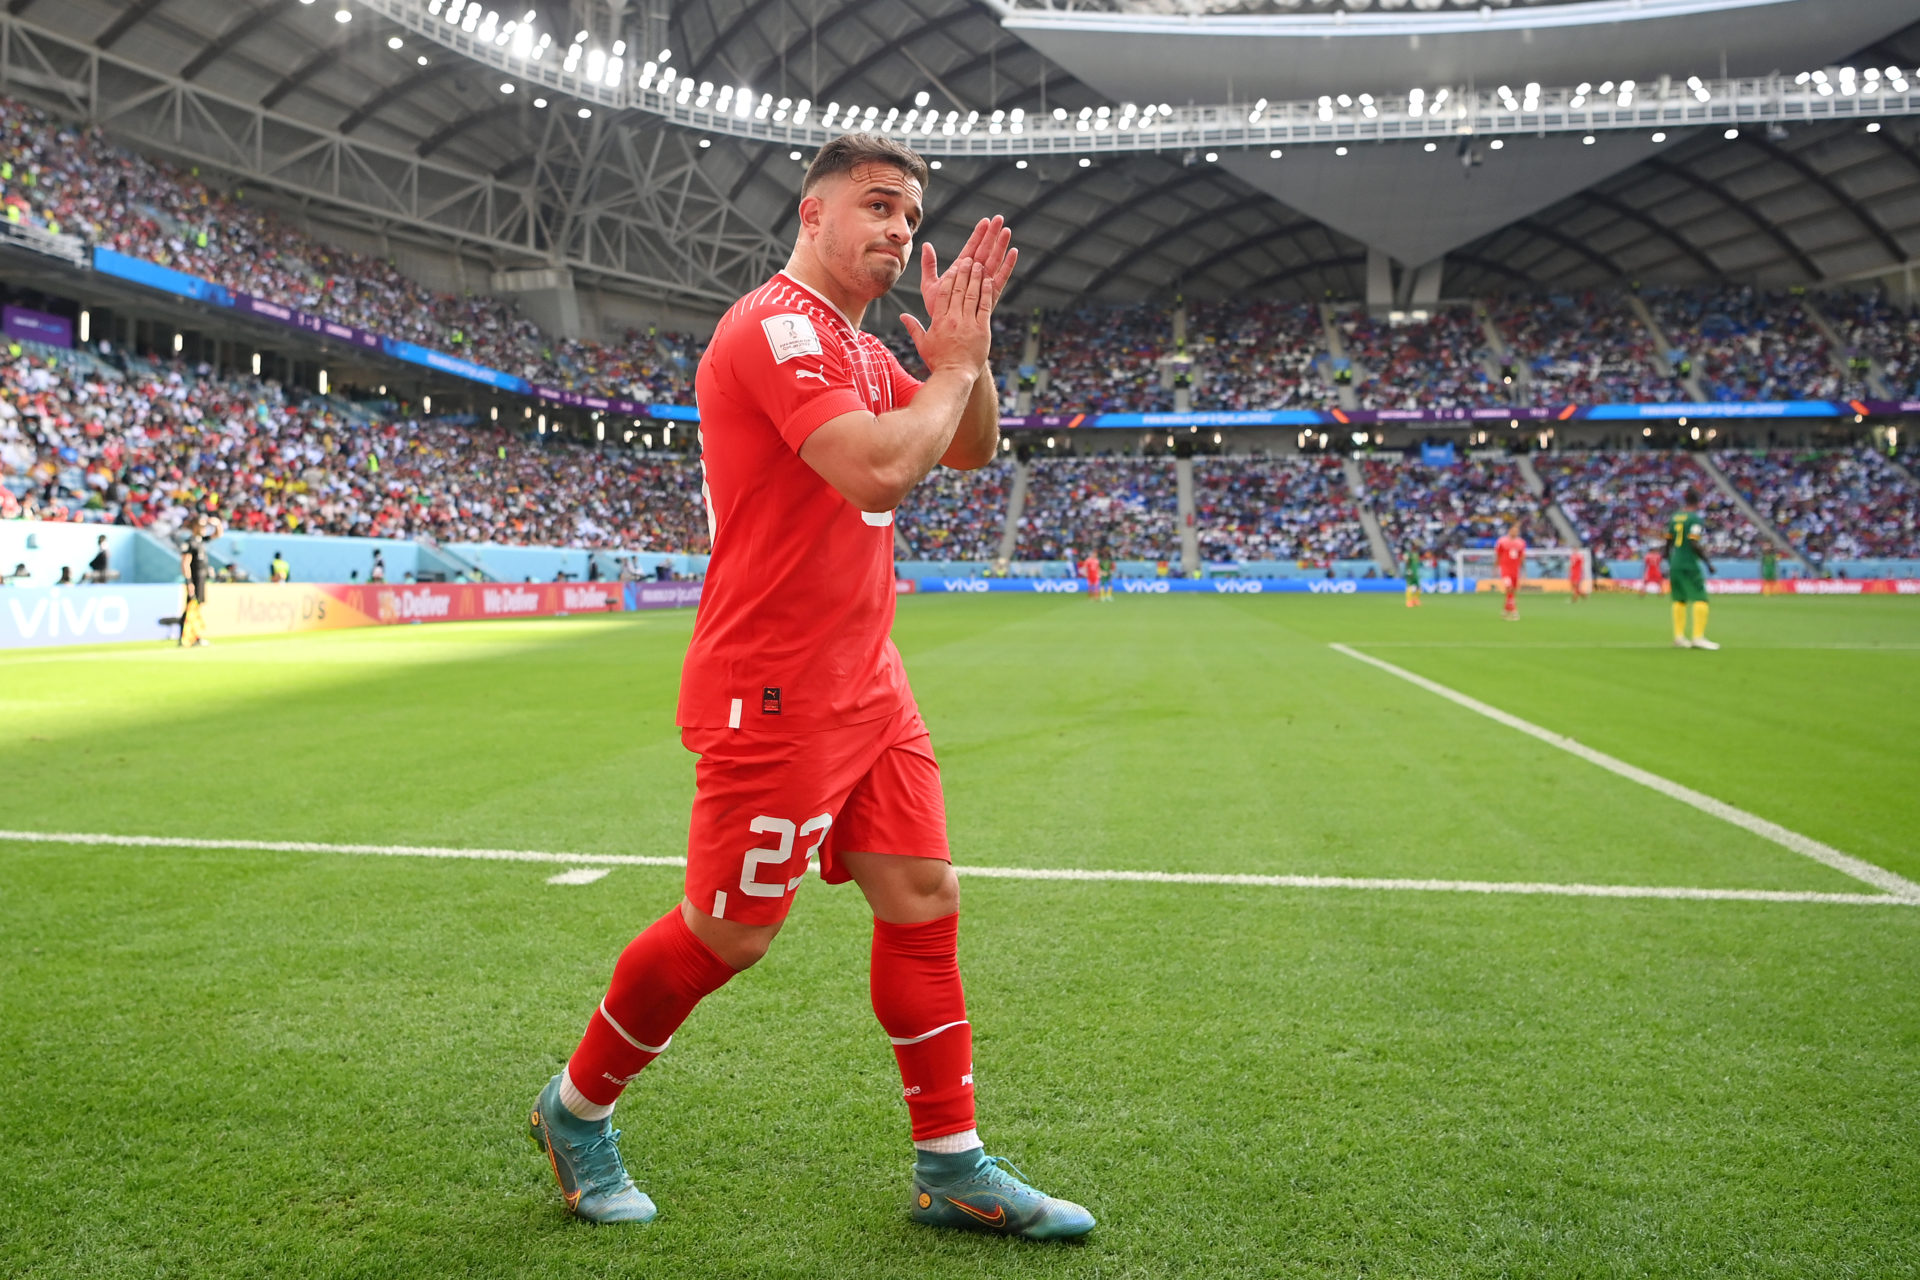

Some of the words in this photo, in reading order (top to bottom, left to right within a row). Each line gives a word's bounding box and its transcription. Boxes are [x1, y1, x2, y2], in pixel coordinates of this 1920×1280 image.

[943, 579, 989, 592] vivo
[1033, 580, 1079, 592] vivo
[1123, 579, 1170, 592] vivo
[1215, 579, 1263, 593] vivo
[1308, 580, 1357, 593] vivo
[403, 587, 450, 617] Deliver
[8, 587, 129, 639] vivo
[236, 595, 298, 631] Maccy
[739, 812, 832, 897] 23
